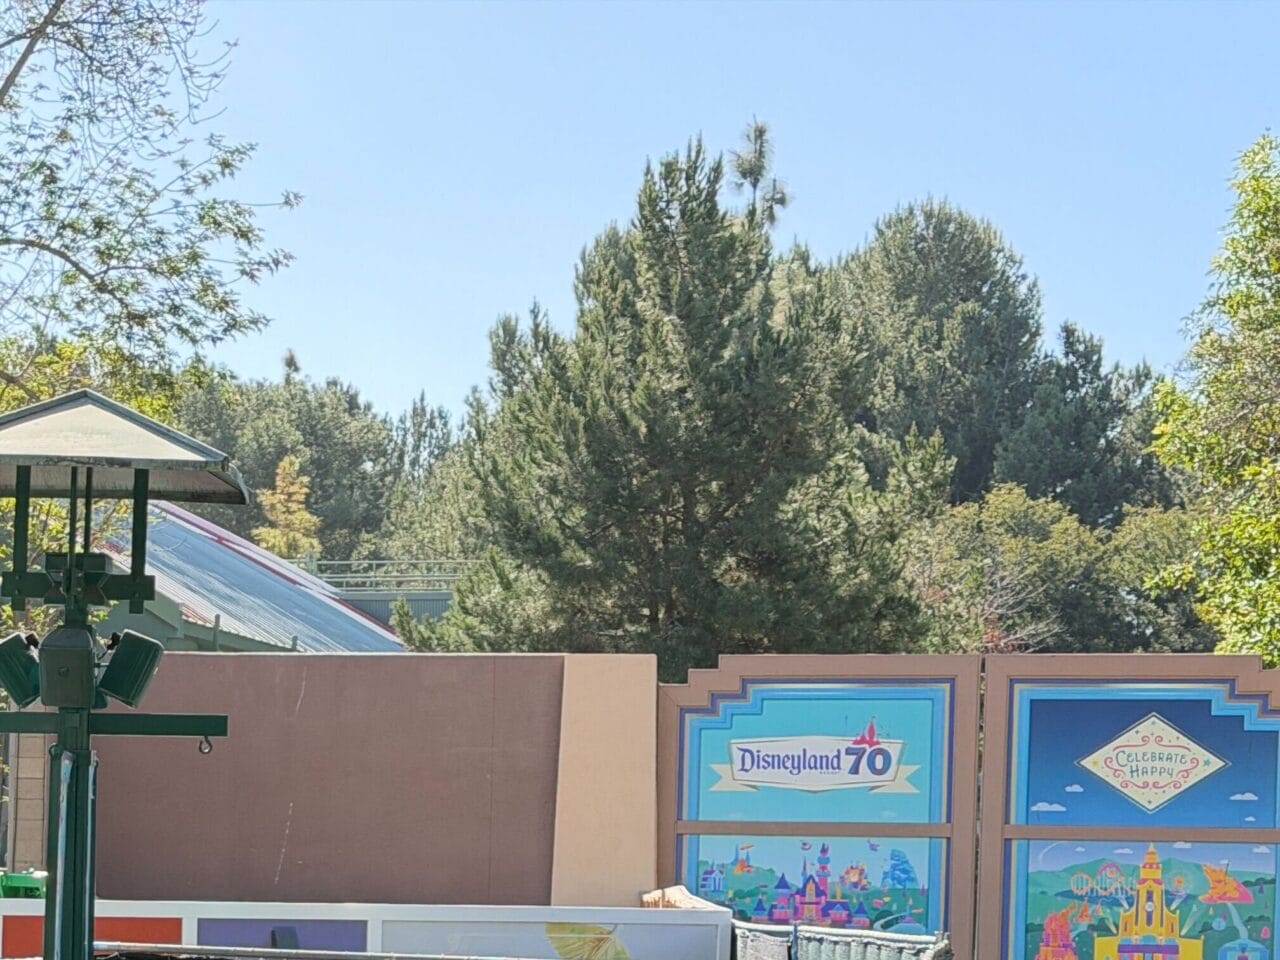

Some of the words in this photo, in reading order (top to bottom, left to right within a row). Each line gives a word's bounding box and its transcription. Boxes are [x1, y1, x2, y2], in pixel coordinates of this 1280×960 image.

[736, 746, 841, 776] Disneyland
[845, 747, 892, 776] 70
[1116, 750, 1188, 768] CELEBRATE
[1129, 765, 1175, 779] HAPPY
